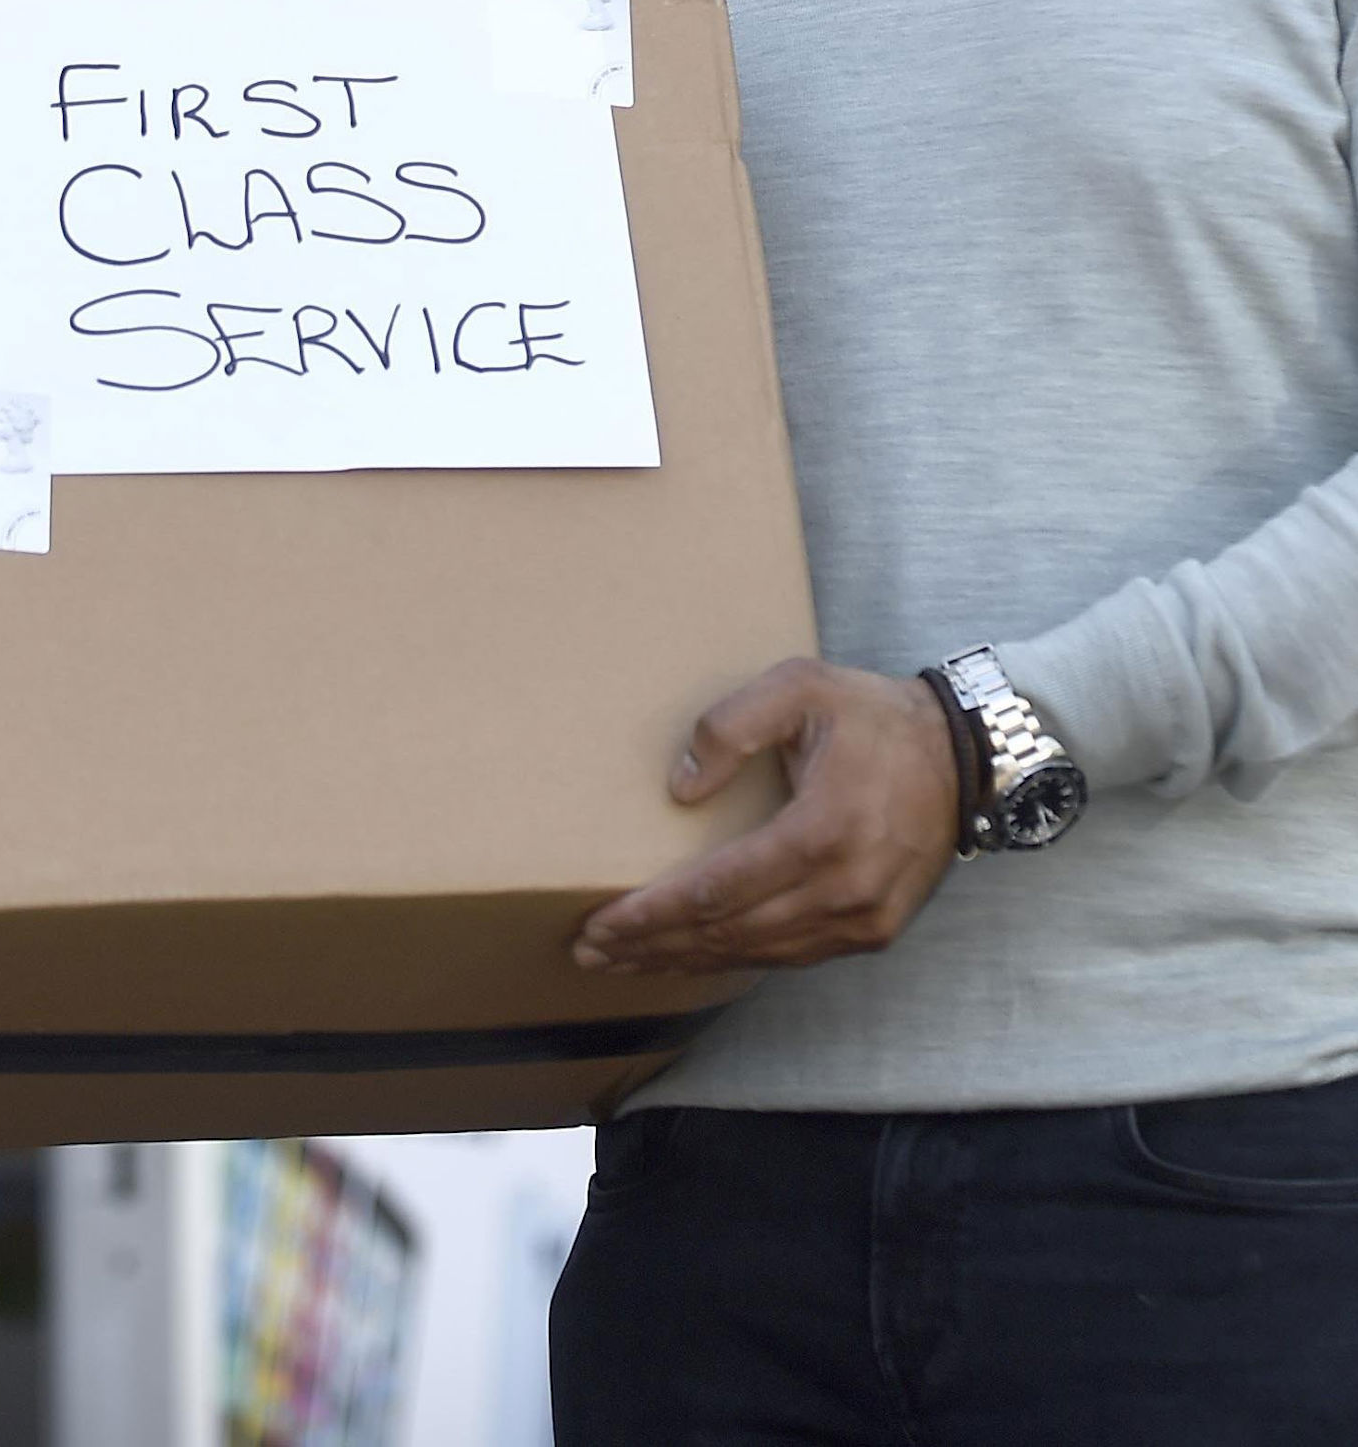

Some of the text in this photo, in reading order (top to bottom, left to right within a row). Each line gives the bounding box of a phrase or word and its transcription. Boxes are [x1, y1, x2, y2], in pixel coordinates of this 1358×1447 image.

[51, 64, 398, 141] FIRST
[59, 162, 486, 265] CLASS
[69, 289, 585, 391] SERVICE
